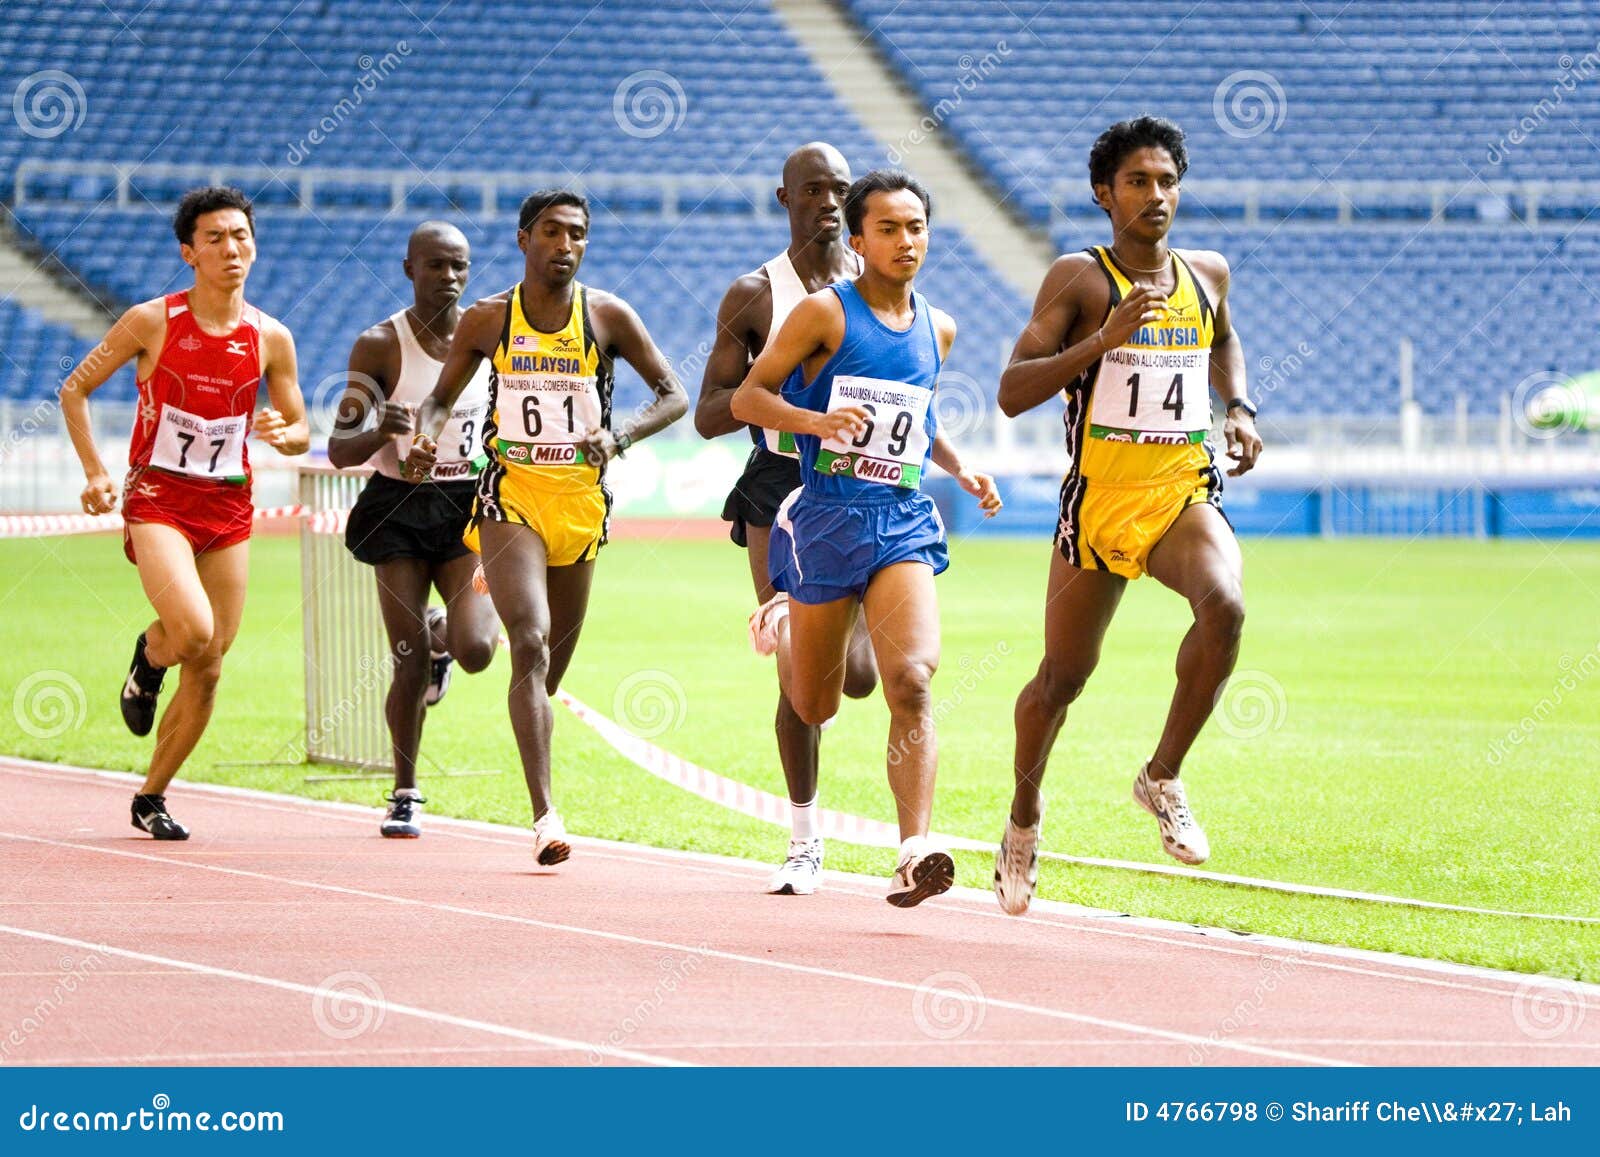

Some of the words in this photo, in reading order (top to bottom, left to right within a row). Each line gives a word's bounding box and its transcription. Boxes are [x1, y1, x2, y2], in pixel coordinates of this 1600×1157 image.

[1126, 327, 1198, 346] MALAYSIA
[511, 356, 580, 374] MALAYSIA
[535, 447, 575, 461] MILO
[434, 463, 469, 477] MILO
[857, 460, 901, 481] MILO
